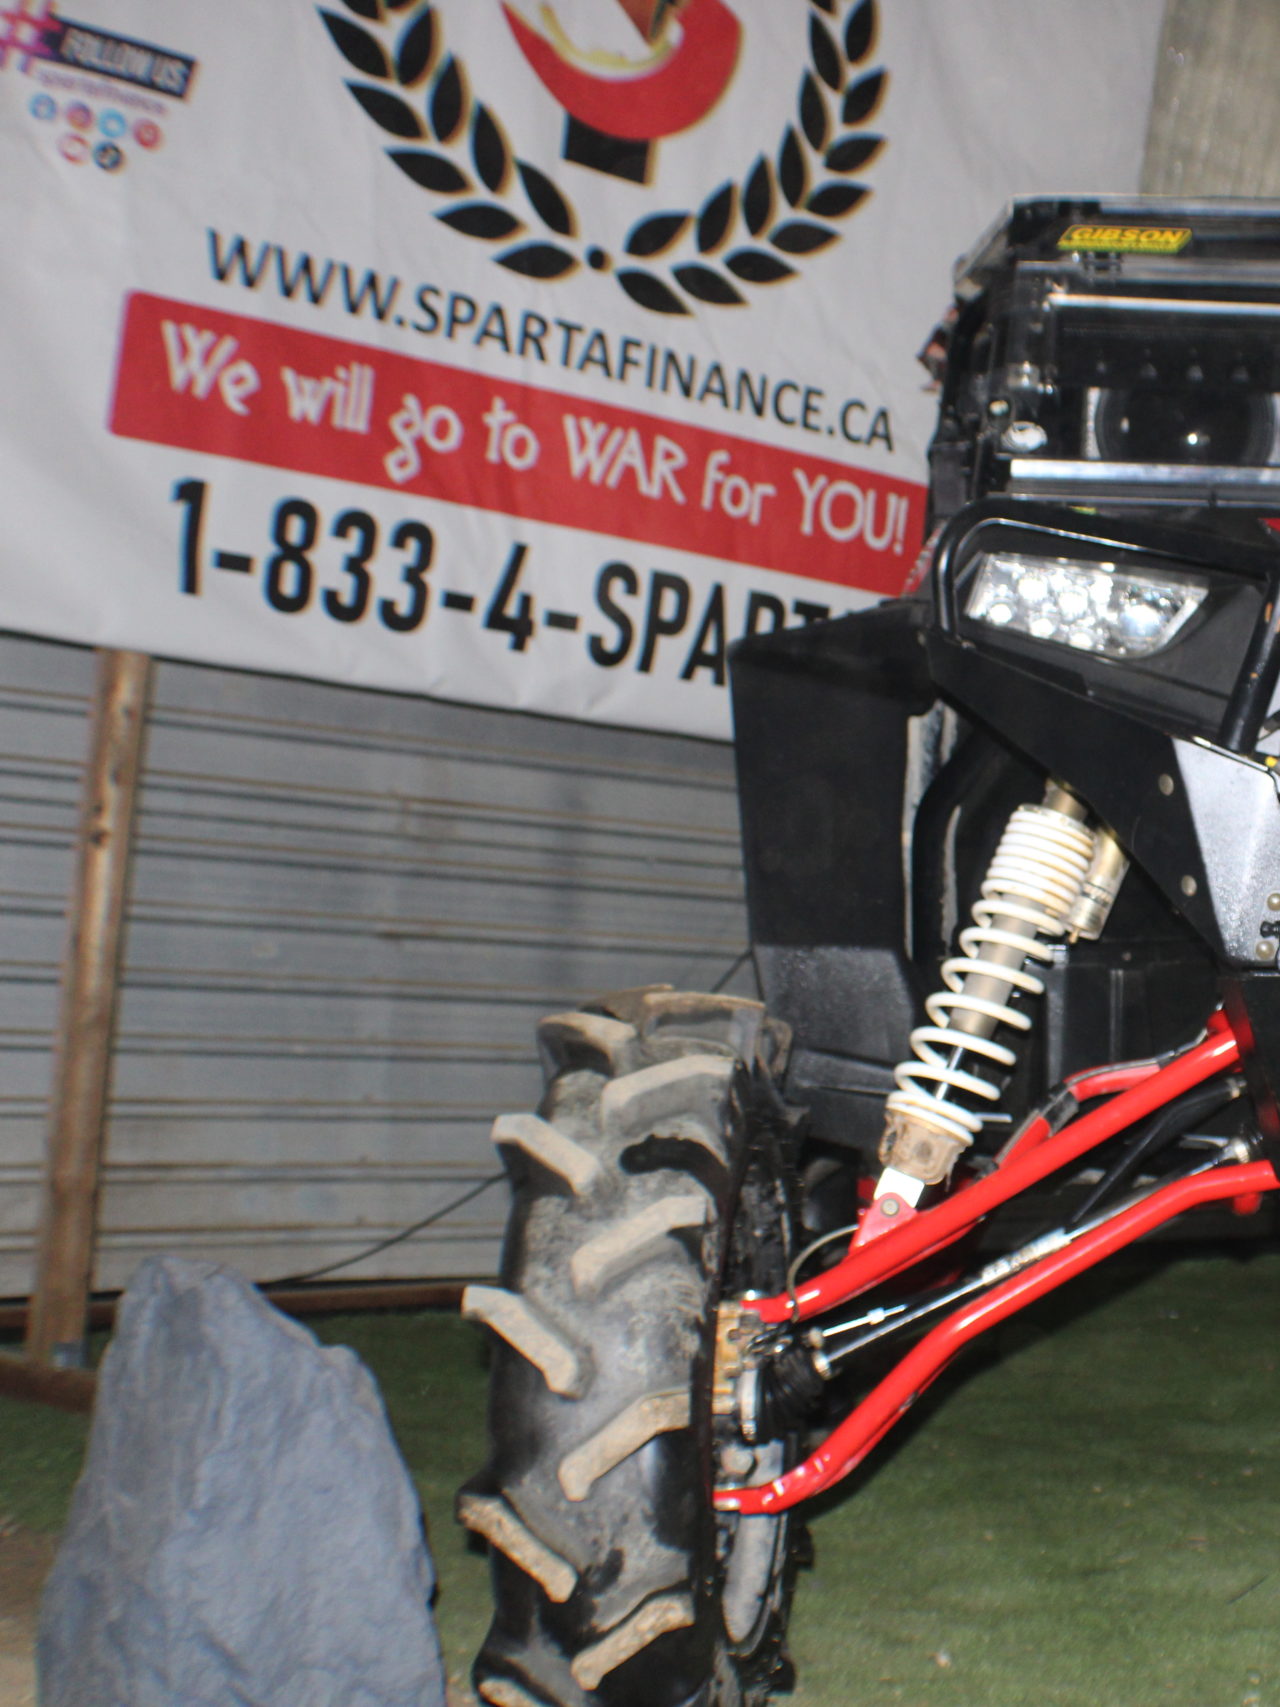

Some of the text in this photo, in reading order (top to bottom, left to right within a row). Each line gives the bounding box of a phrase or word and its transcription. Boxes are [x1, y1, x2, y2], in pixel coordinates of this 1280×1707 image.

[207, 228, 895, 453] WWW.SPARTAFINANCE.CA
[1071, 227, 1182, 243] GIBSON
[161, 319, 910, 557] We will go to WAR for YOU!
